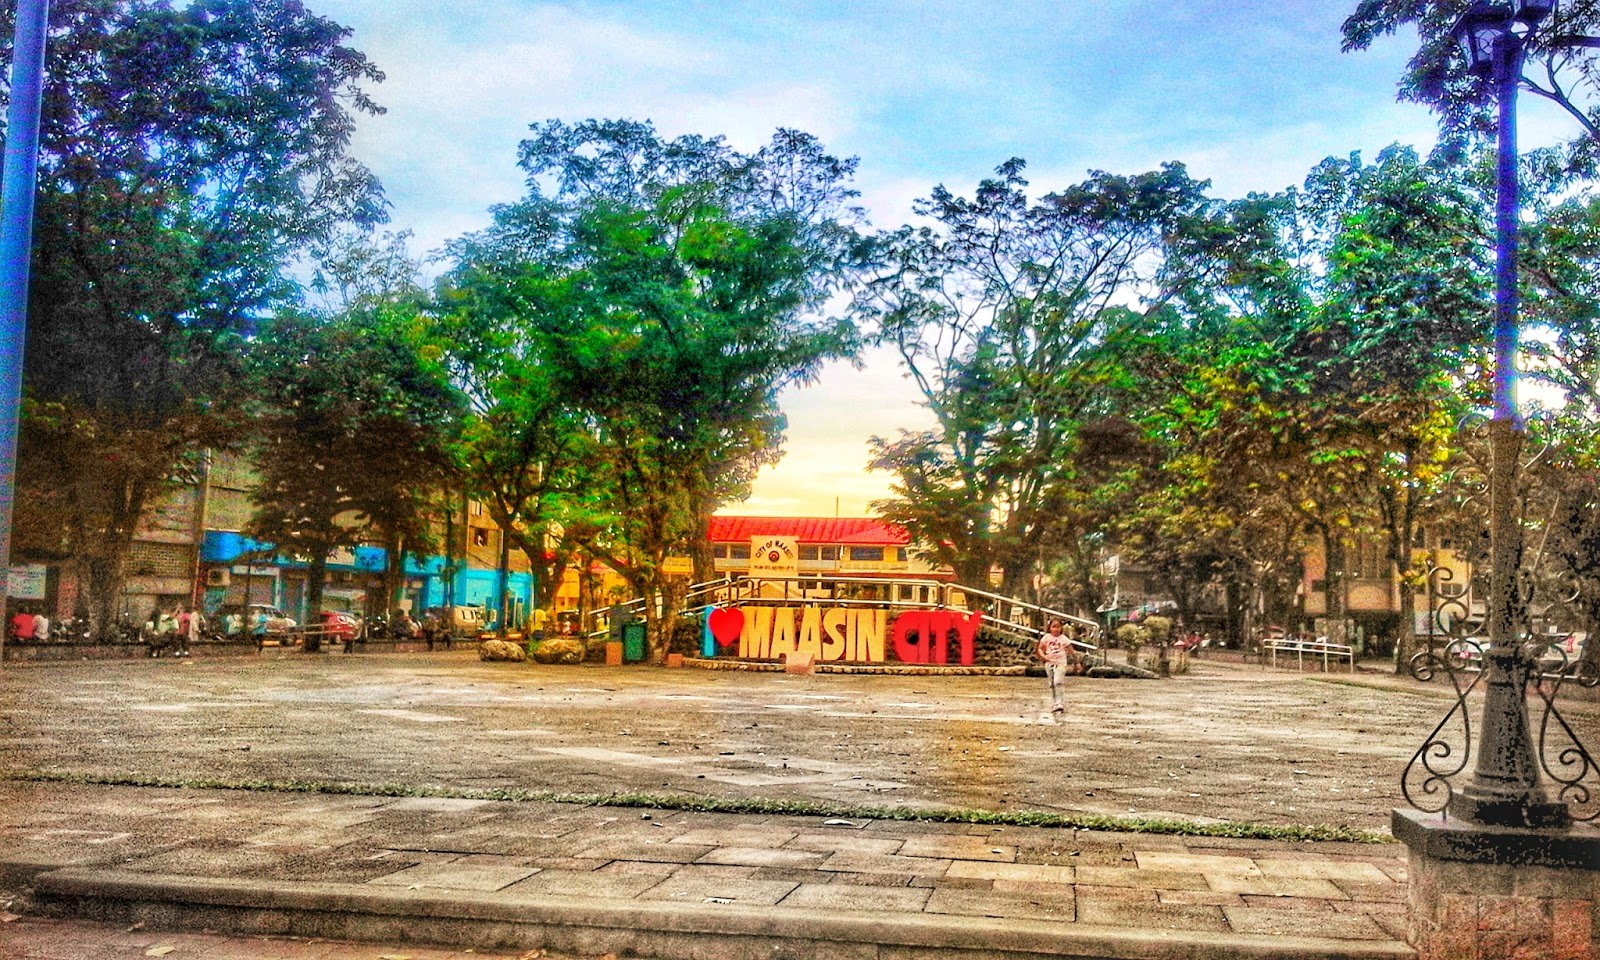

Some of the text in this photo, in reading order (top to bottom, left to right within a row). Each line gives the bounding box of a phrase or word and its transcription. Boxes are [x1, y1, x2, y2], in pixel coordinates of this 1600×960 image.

[755, 545, 767, 559] CITY
[765, 540, 773, 549] OF
[701, 605, 983, 666] I MAASIN CITY
